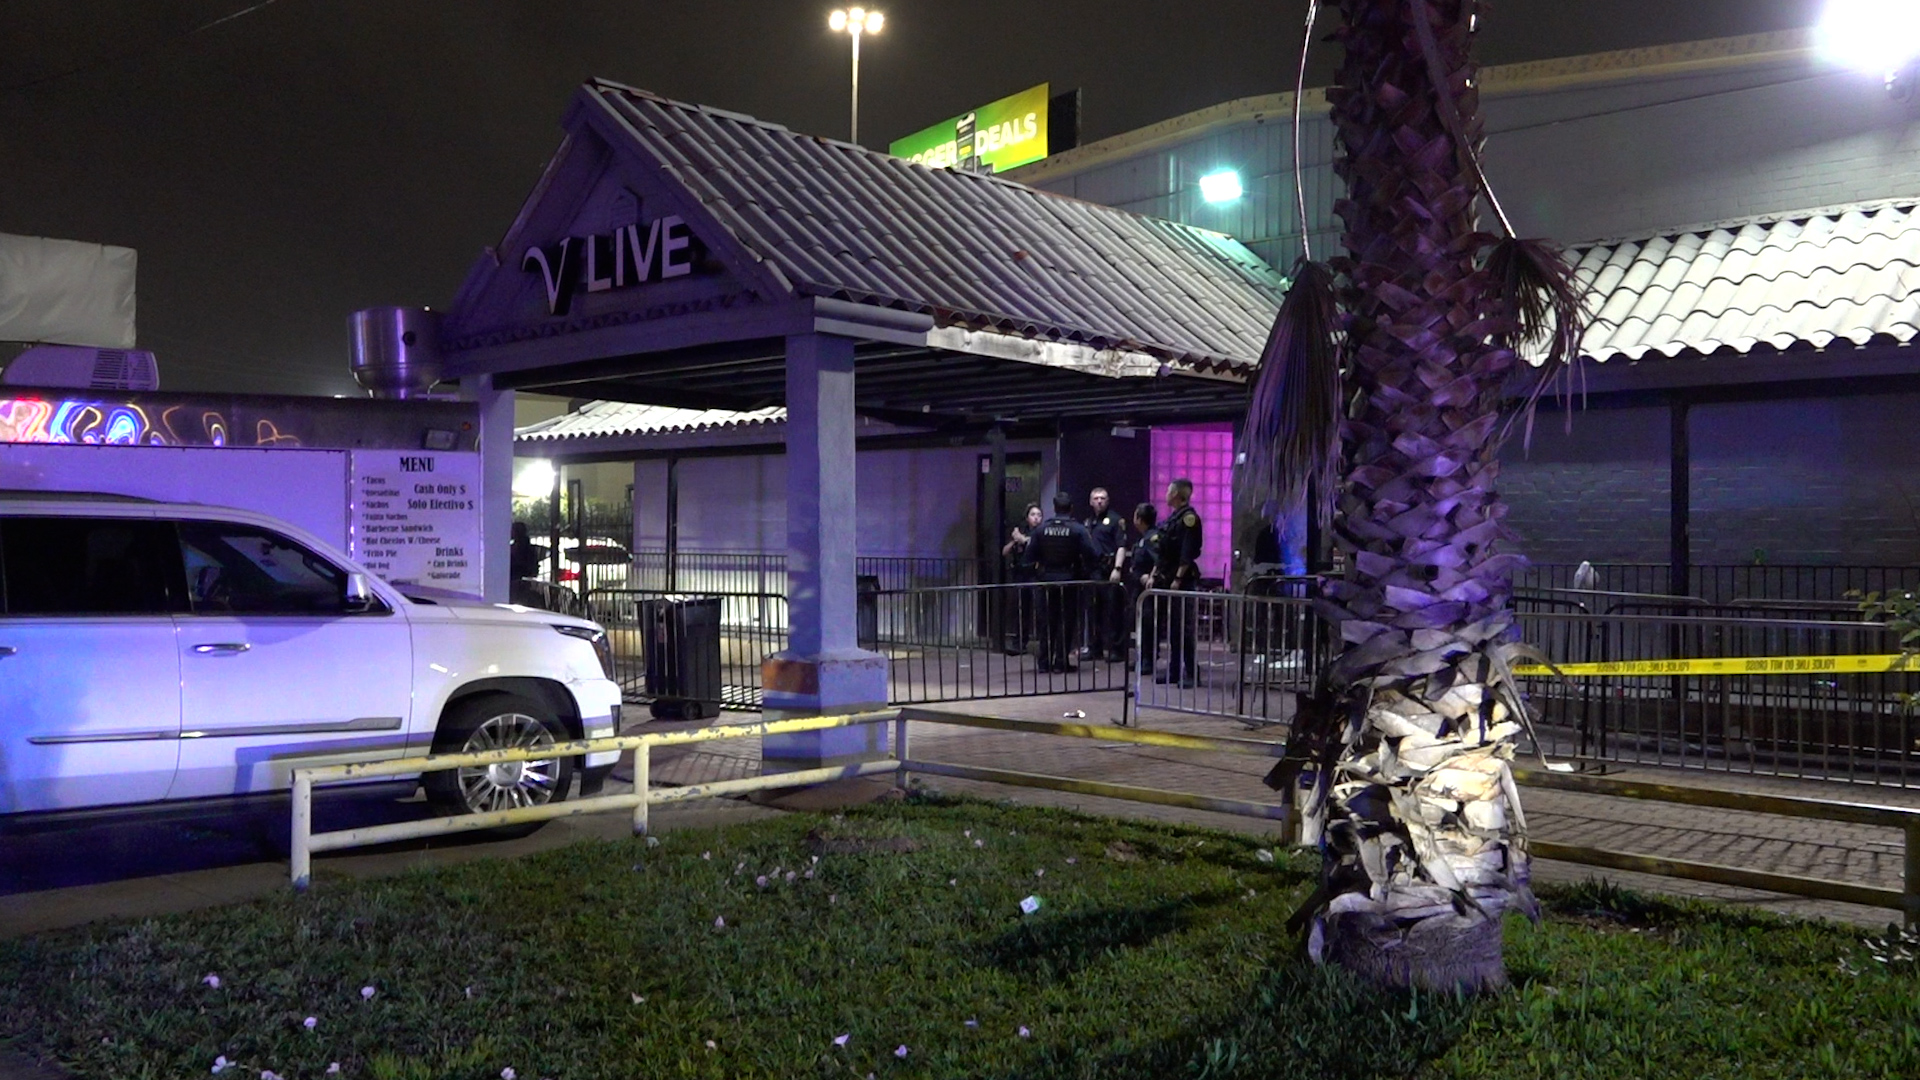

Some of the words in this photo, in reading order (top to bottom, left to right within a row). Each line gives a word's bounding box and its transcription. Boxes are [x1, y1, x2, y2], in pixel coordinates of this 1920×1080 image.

[975, 112, 1037, 156] DEALS
[521, 236, 571, 314] V
[588, 215, 691, 292] LIVE
[400, 456, 434, 472] MENU
[414, 484, 434, 494] Cash
[437, 484, 456, 496] Only
[407, 499, 427, 509] Solo
[1044, 527, 1069, 536] POLICE
[436, 547, 463, 556] Drinks
